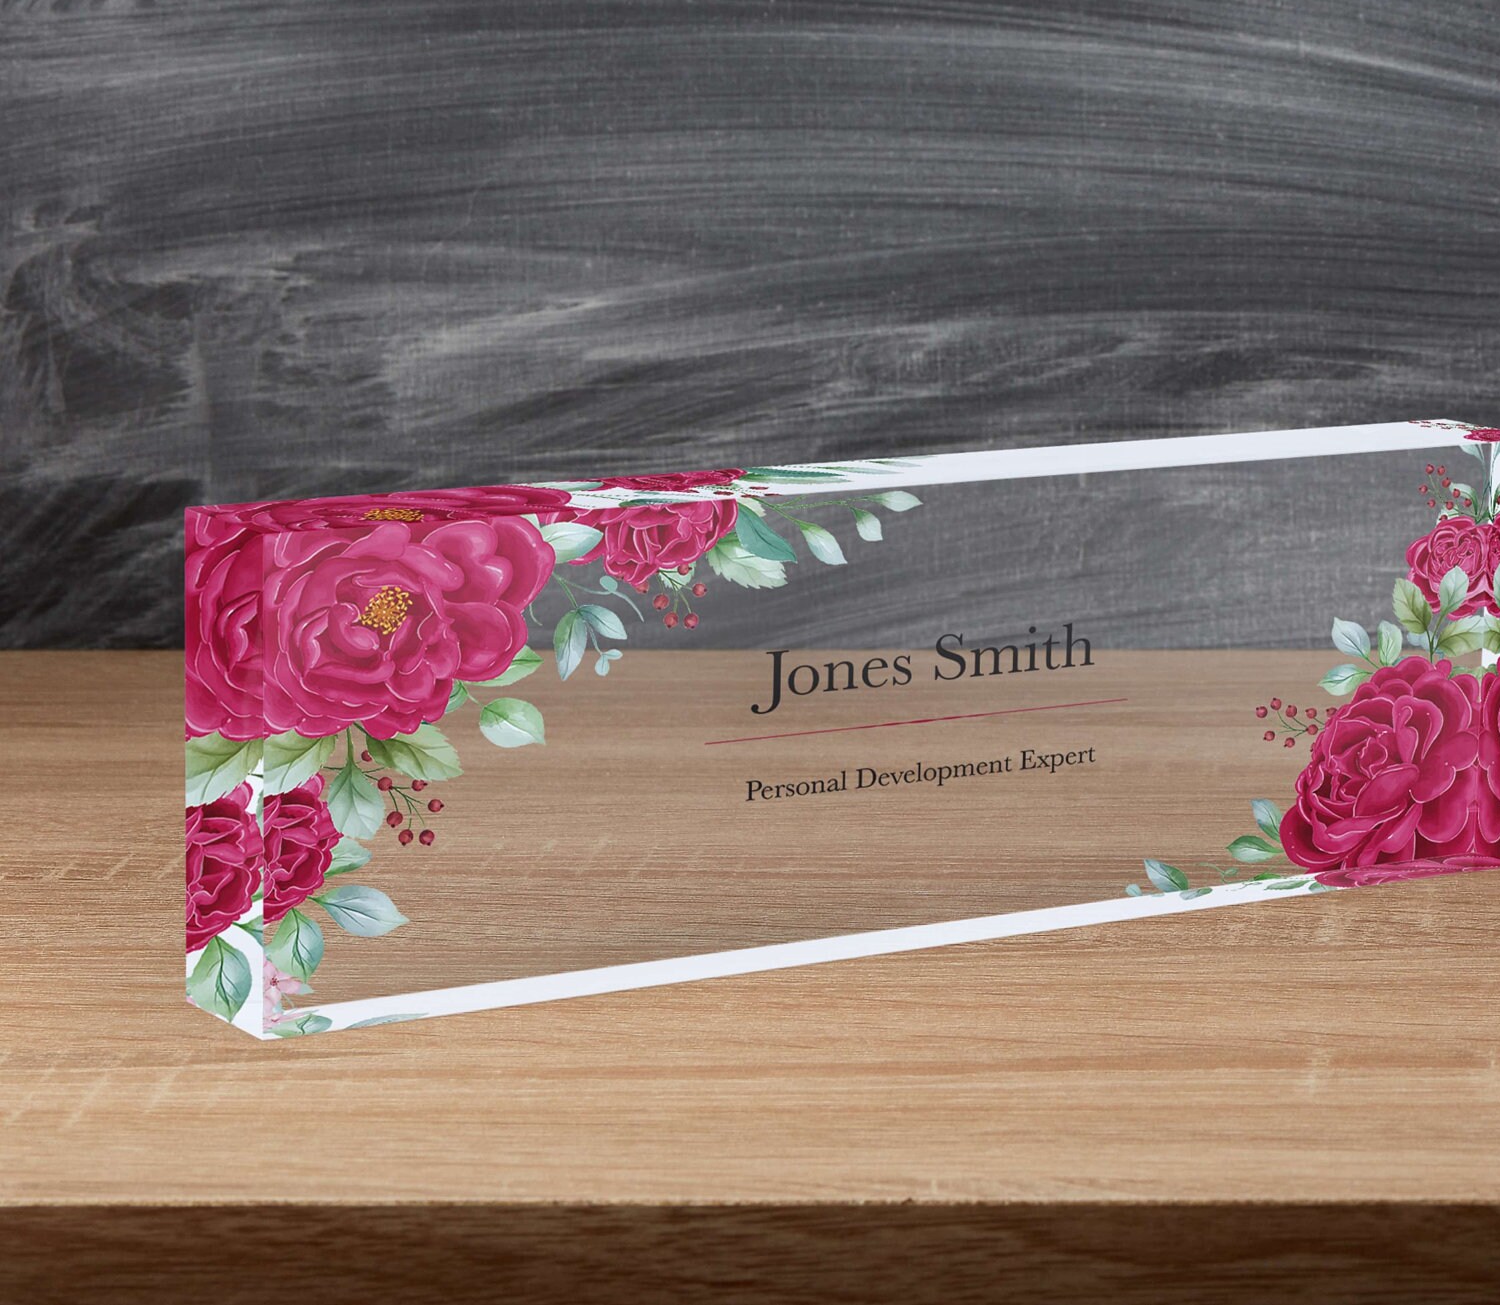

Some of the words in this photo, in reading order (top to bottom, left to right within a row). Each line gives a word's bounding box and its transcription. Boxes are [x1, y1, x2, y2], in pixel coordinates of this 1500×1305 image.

[750, 649, 913, 715] Jones
[934, 622, 1096, 681] Smith
[744, 770, 848, 802] Personal
[855, 755, 1013, 790] Development
[1018, 746, 1096, 775] Expert
